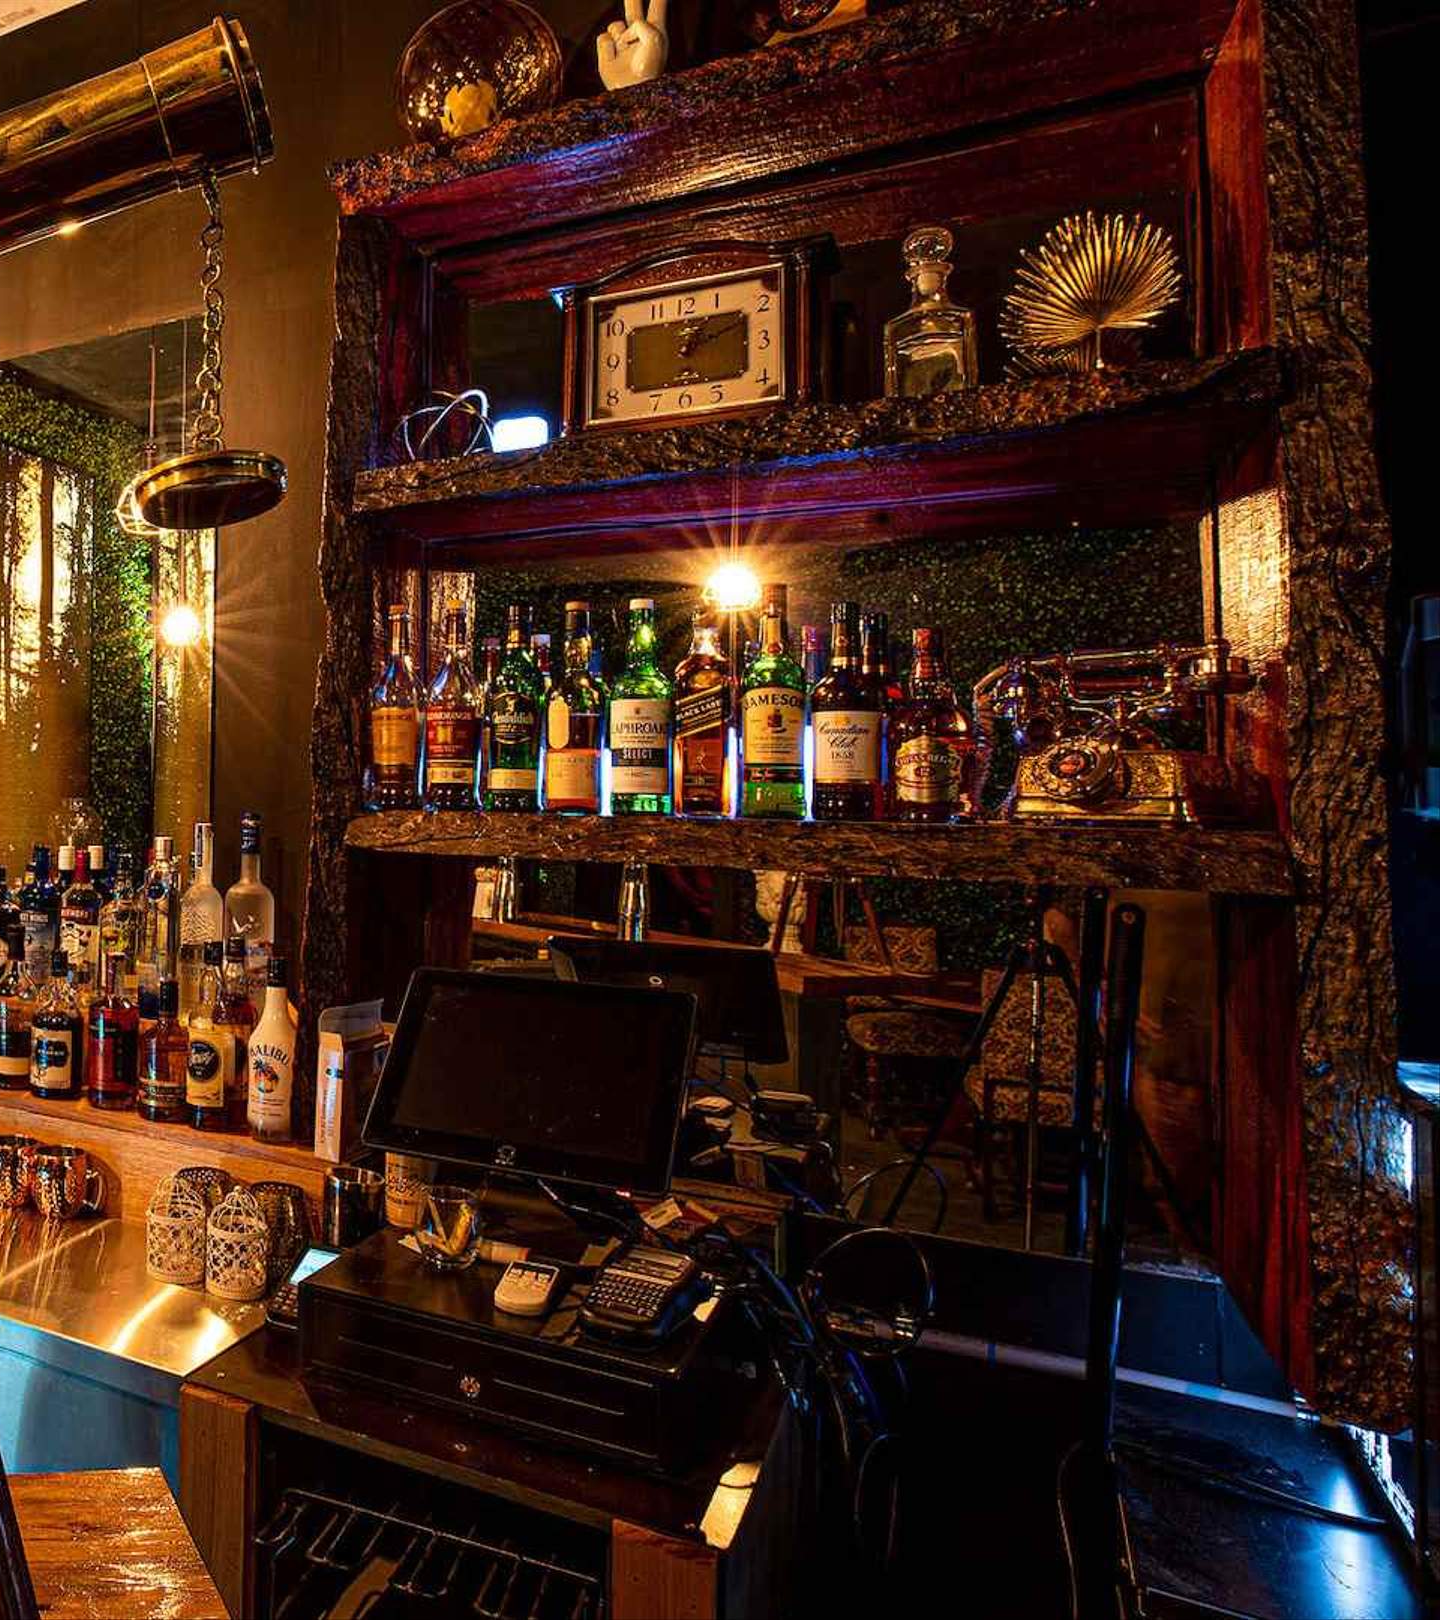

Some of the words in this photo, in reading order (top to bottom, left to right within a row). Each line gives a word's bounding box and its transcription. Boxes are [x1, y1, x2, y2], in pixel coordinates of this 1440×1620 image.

[651, 303, 664, 321] 11
[677, 297, 696, 316] 12
[756, 294, 771, 313] 2
[606, 319, 625, 338] 10
[757, 329, 771, 350] 3
[606, 353, 621, 372] 9
[755, 367, 770, 385] 4
[606, 388, 620, 406] 8
[648, 393, 663, 412] 7
[678, 390, 693, 409] 6
[710, 384, 723, 404] 5
[623, 747, 653, 760] SELECT
